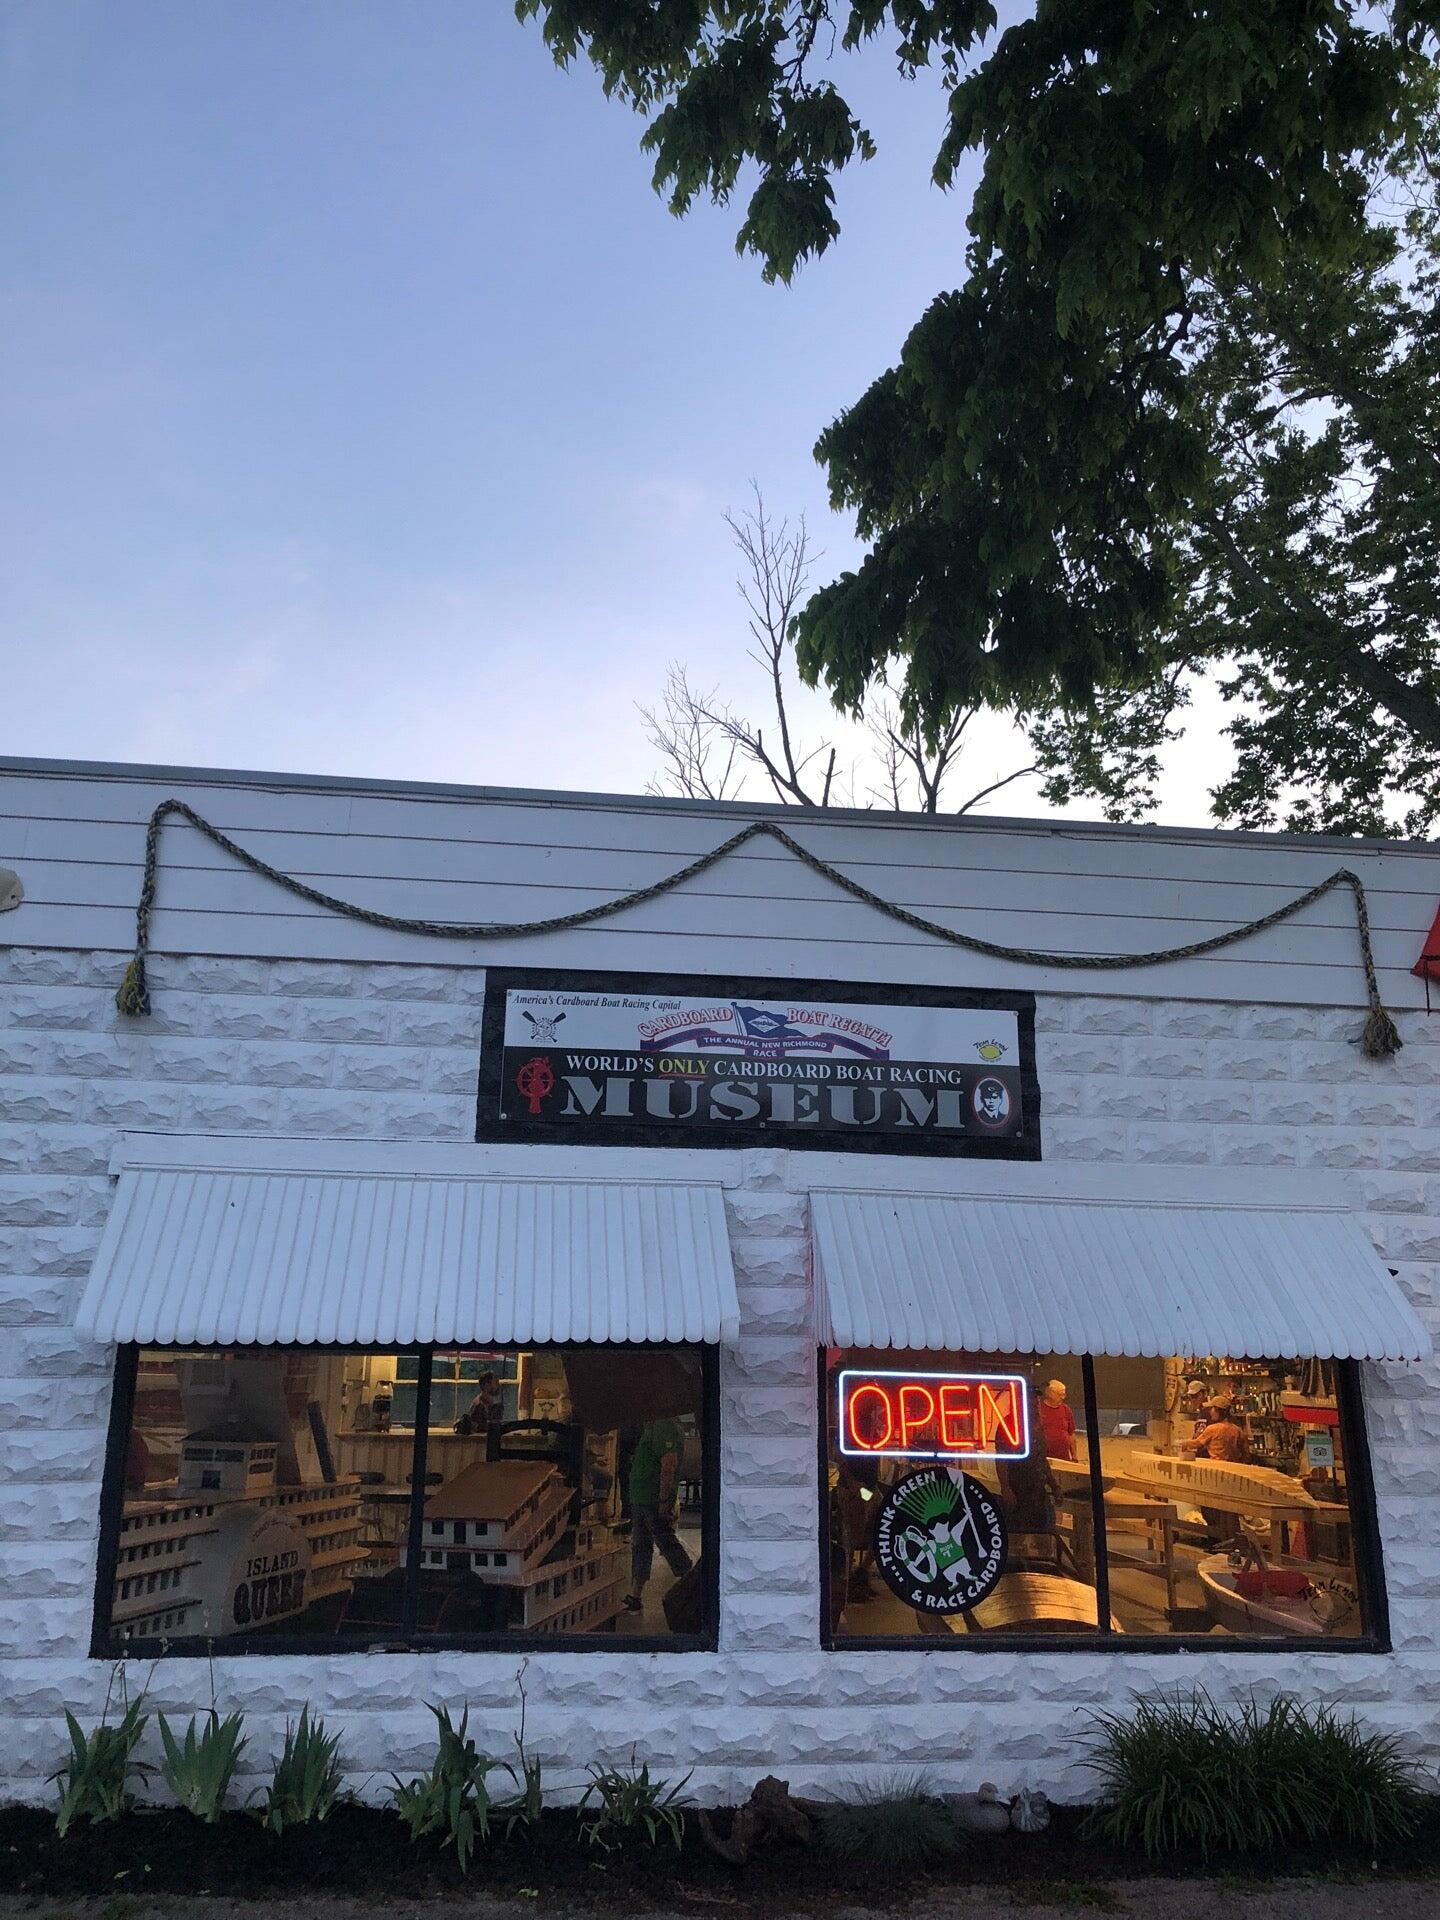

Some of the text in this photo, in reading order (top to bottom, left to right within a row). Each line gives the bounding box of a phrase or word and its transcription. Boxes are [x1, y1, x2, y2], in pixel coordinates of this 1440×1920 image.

[512, 994, 682, 1012] America's Cardboard Boat Racing Capital
[638, 1006, 893, 1048] CARDBOARD BOAT REGATTA
[703, 1036, 828, 1049] THE ANNUAL NEW RICHMOND
[752, 1049, 778, 1058] RACE
[566, 1054, 962, 1085] WORLD'S ONLY CARDBOARD BOAT RACING
[560, 1075, 966, 1129] MUSEUM
[848, 1380, 1020, 1450] OPEN
[892, 1470, 937, 1507] GREEN
[246, 1550, 299, 1578] ISLAND
[911, 1589, 923, 1603] &
[925, 1591, 967, 1609] RACE
